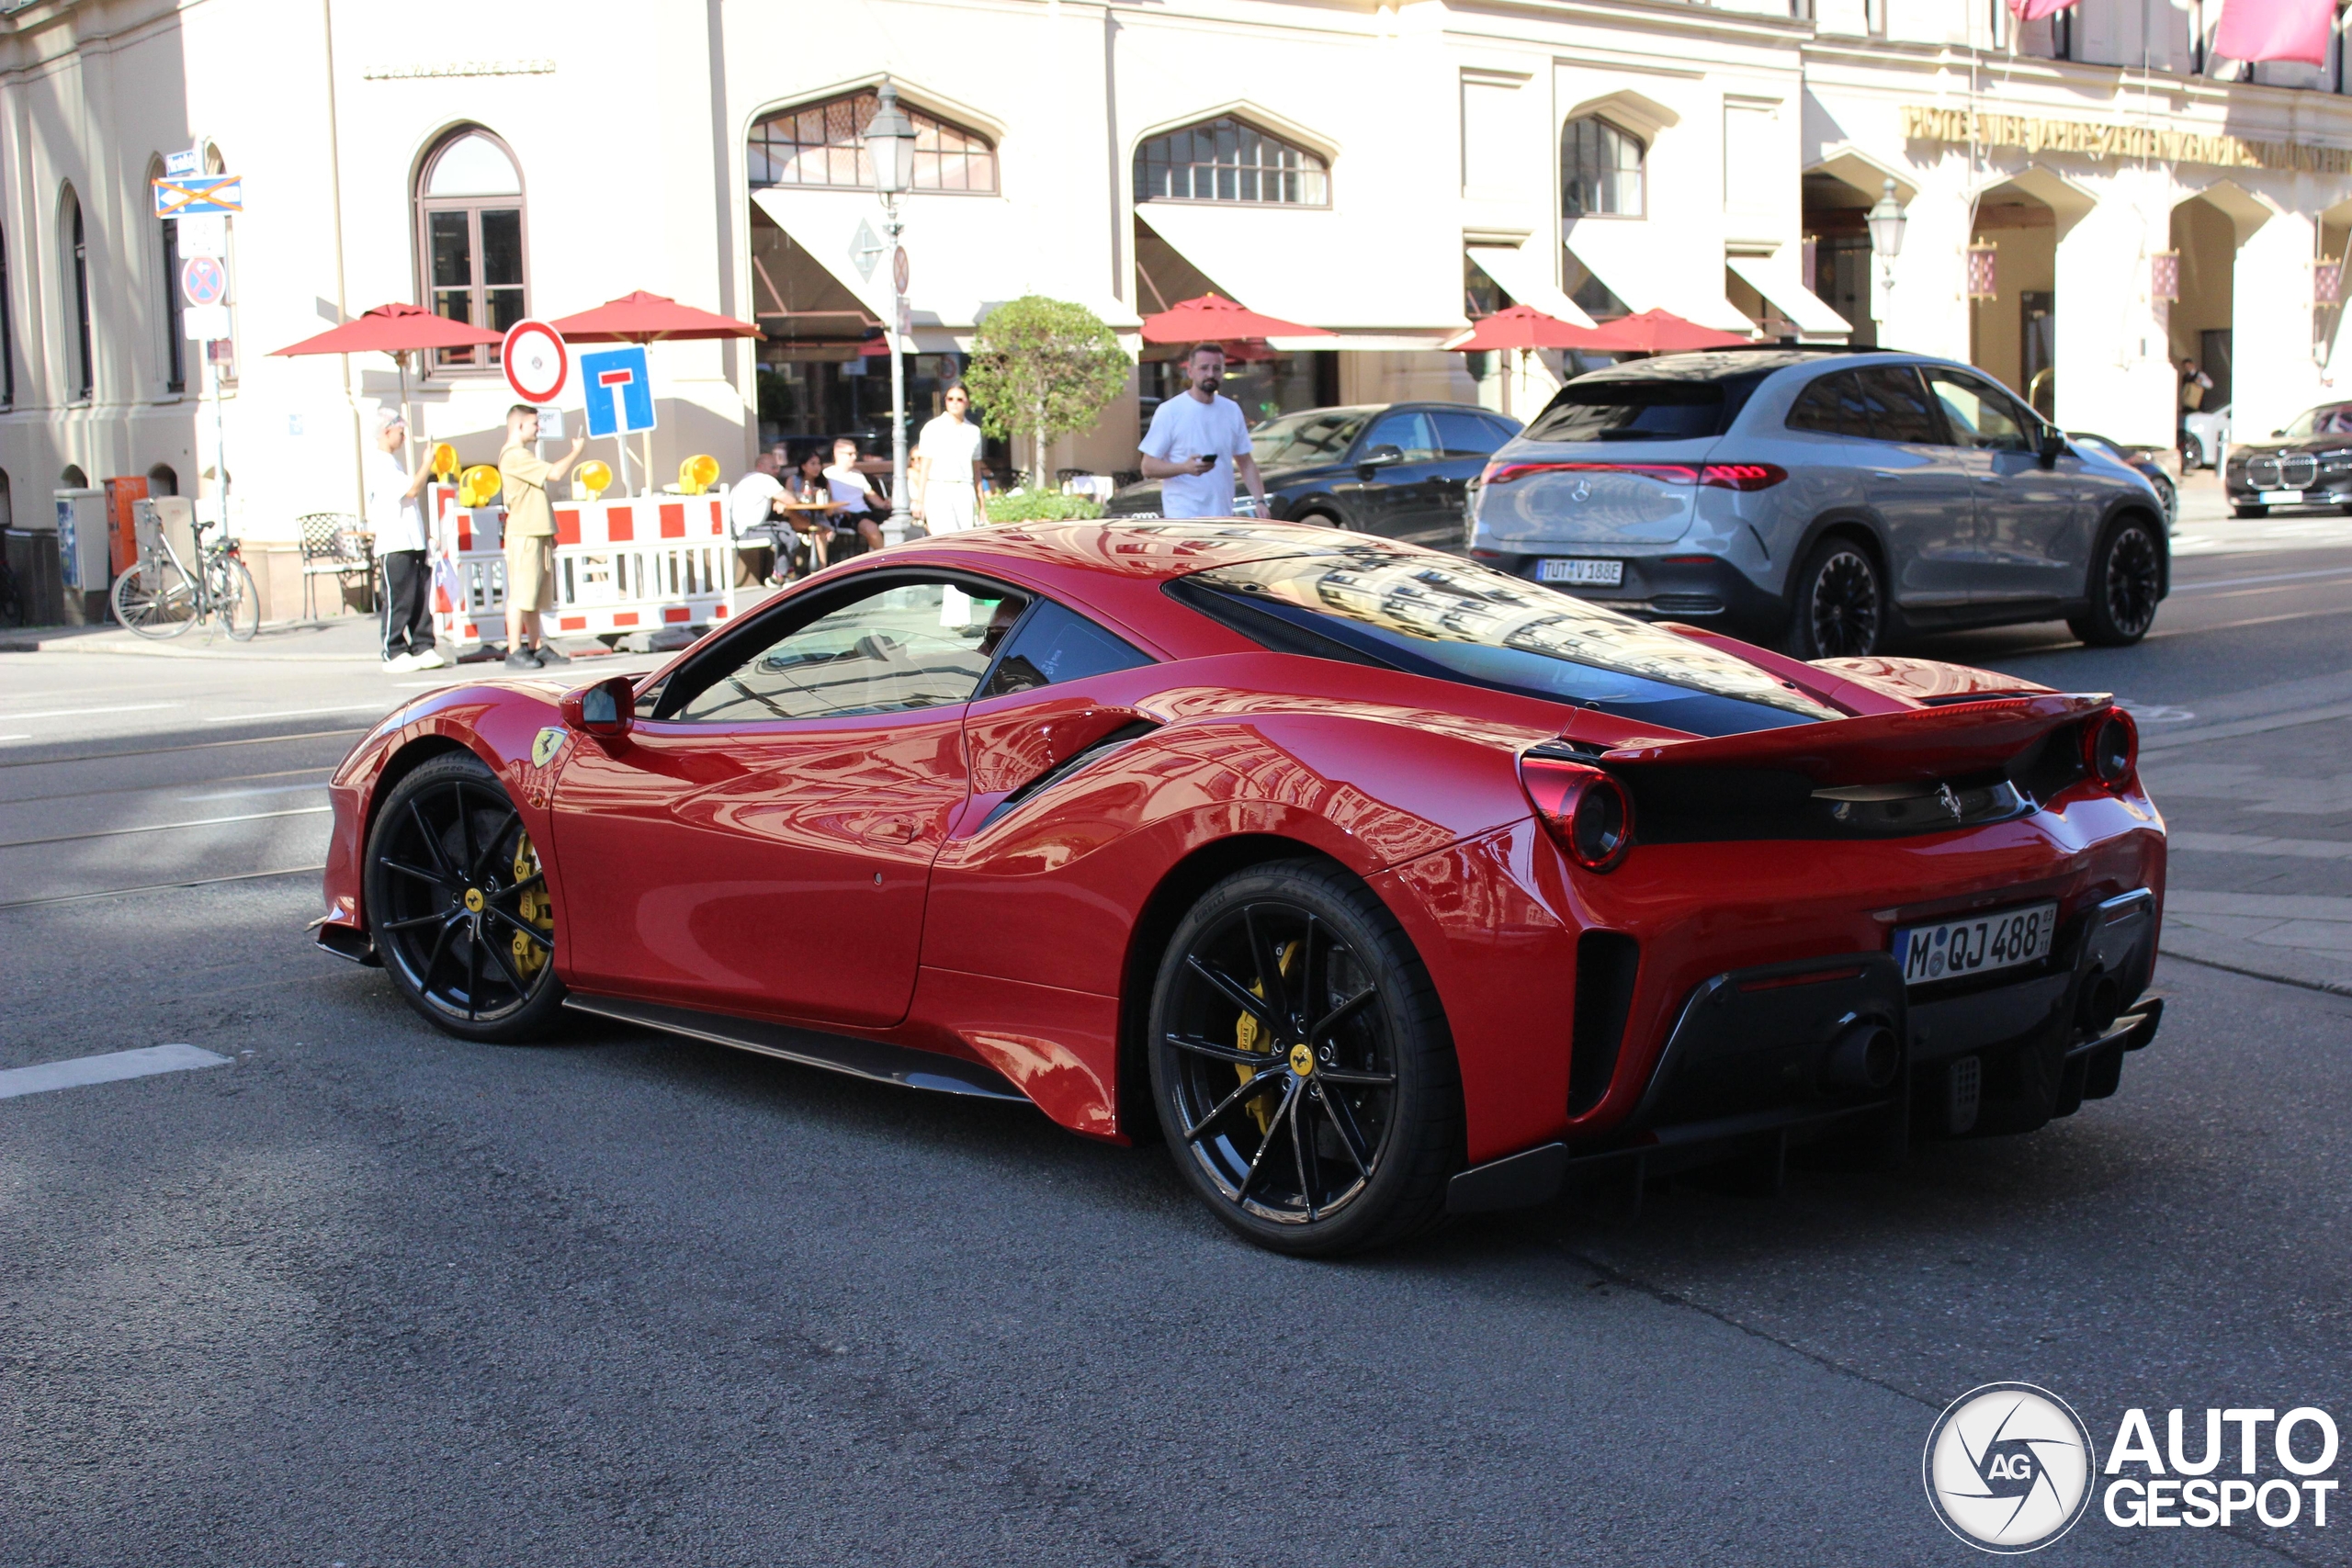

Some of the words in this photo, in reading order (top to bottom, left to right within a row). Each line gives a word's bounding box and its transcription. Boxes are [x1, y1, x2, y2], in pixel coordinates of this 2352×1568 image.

[1545, 562, 1567, 579] TUT
[1577, 563, 1586, 579] V
[1588, 563, 1622, 581] 188E
[2042, 908, 2054, 922] 03
[1906, 931, 1932, 979] M
[1948, 923, 1988, 971] QJ
[1991, 912, 2040, 964] 488
